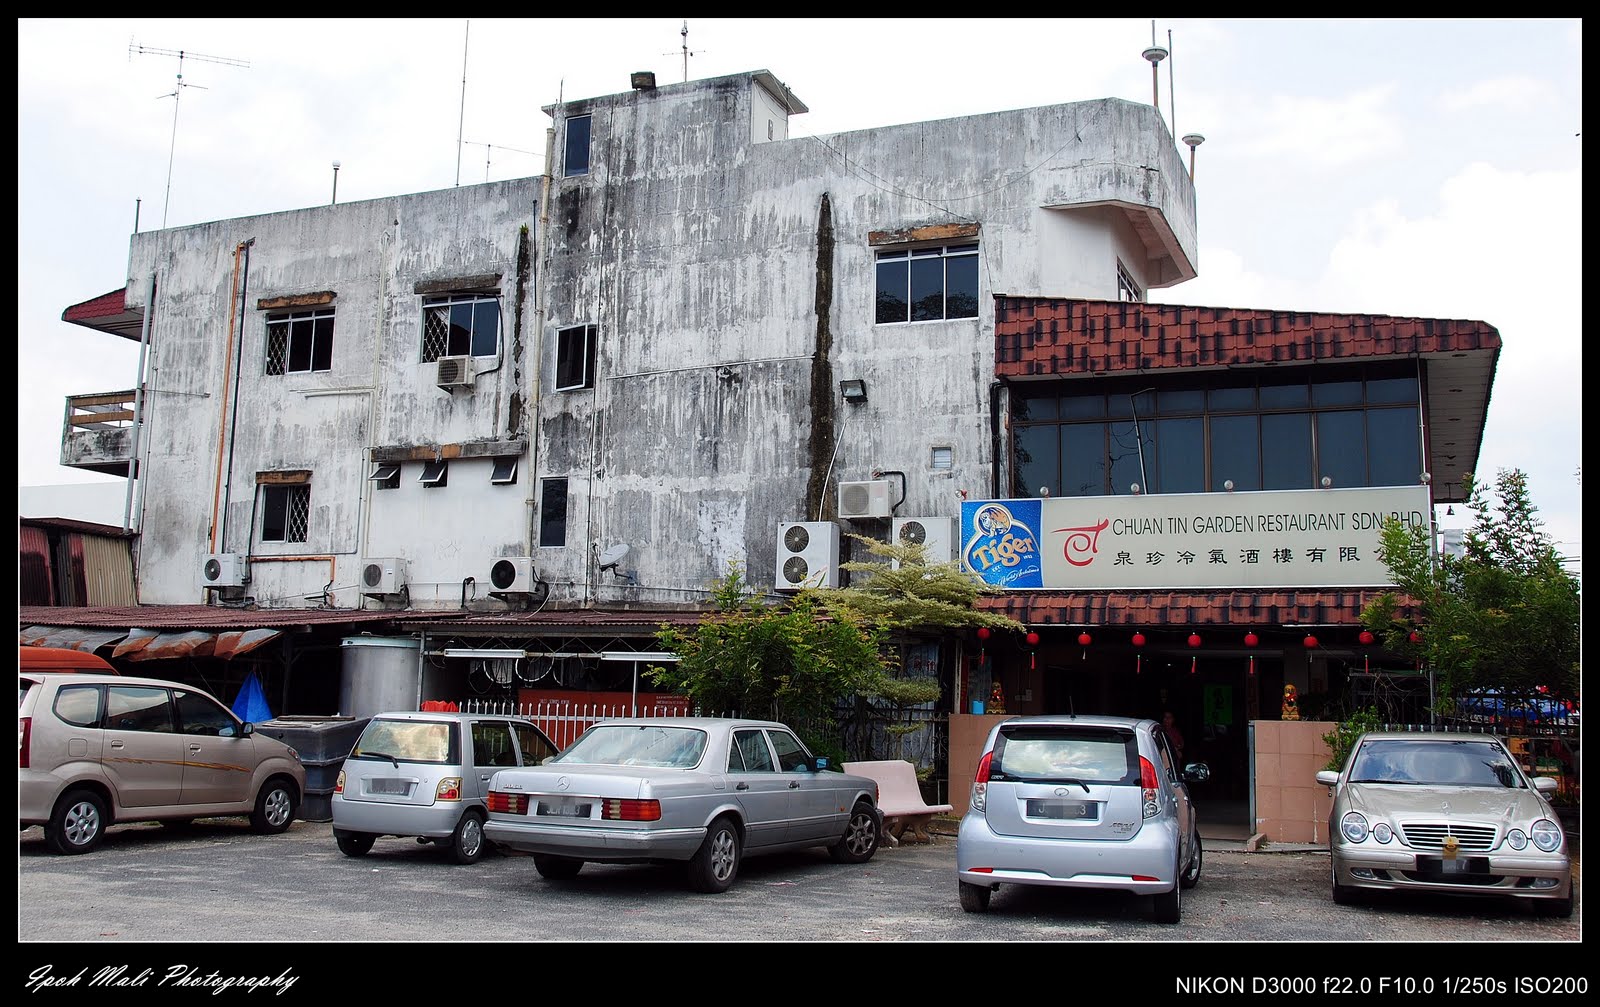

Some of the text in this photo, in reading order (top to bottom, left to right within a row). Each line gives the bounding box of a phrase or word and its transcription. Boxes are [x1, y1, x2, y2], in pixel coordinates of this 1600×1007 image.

[1112, 518, 1163, 536] CHUAN
[1167, 517, 1188, 534] TIN
[1192, 515, 1254, 534] GARDEN
[1257, 513, 1346, 532] RESTAURANT
[1351, 511, 1383, 531] SDN
[972, 533, 1035, 570] Tiger
